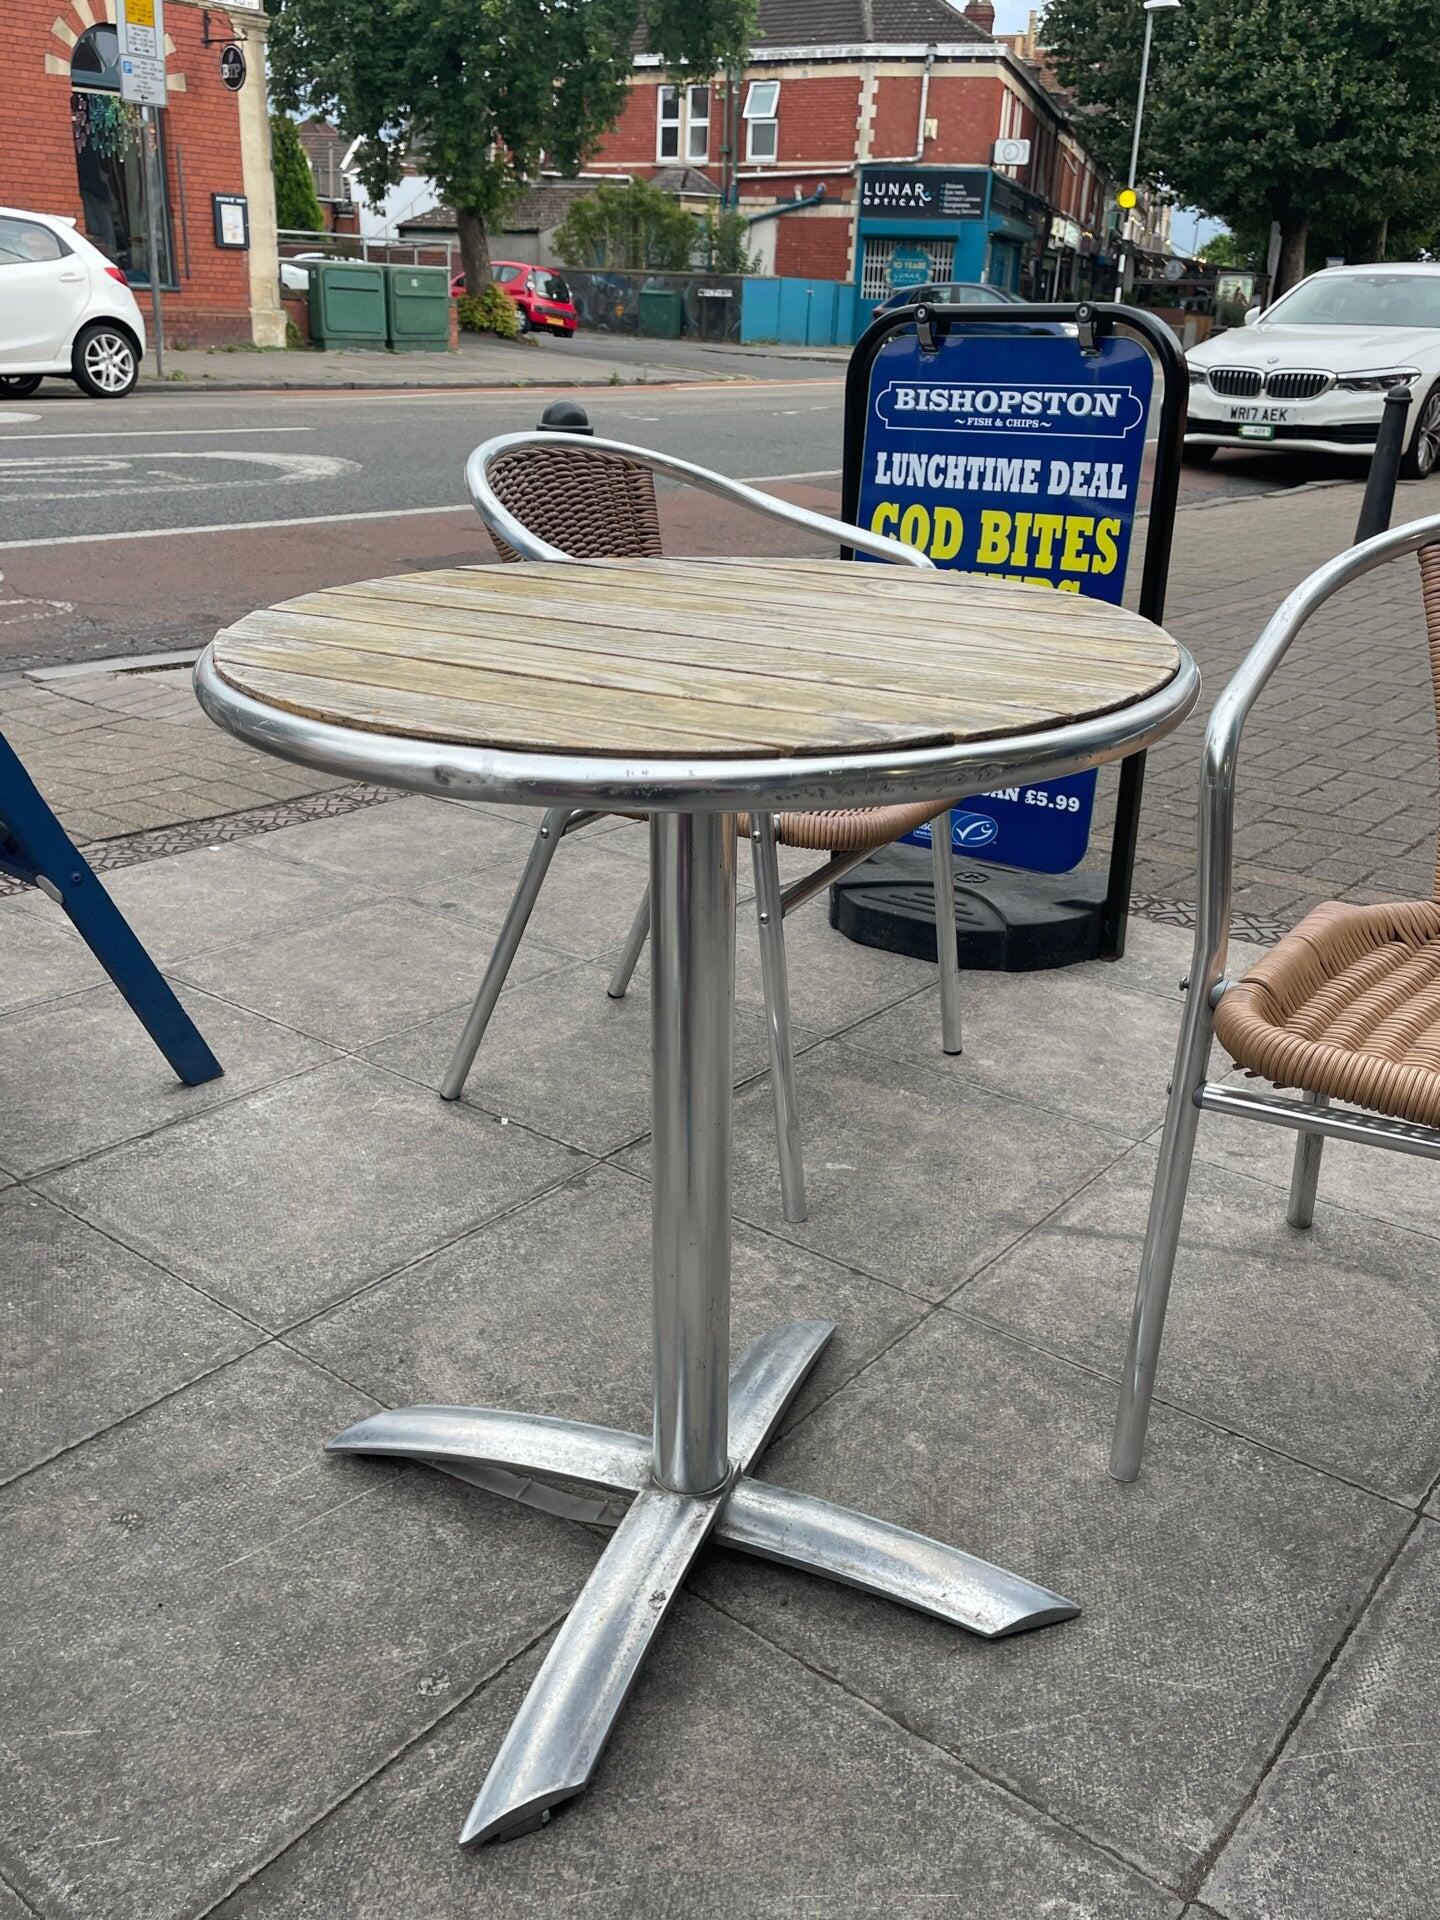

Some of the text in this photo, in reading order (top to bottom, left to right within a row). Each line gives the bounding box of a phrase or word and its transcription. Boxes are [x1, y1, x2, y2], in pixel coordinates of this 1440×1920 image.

[863, 197, 925, 207] OPTICAL
[864, 182, 932, 202] LUNAR
[894, 388, 1122, 418] BISHOPSTON
[966, 417, 1040, 428] FISH & CHIPS
[1230, 407, 1288, 422] WR17 AEK
[874, 451, 1127, 499] LUNCHTIME DEAL
[870, 501, 1121, 575] COD BITES
[981, 787, 1080, 812] AN £5.99
